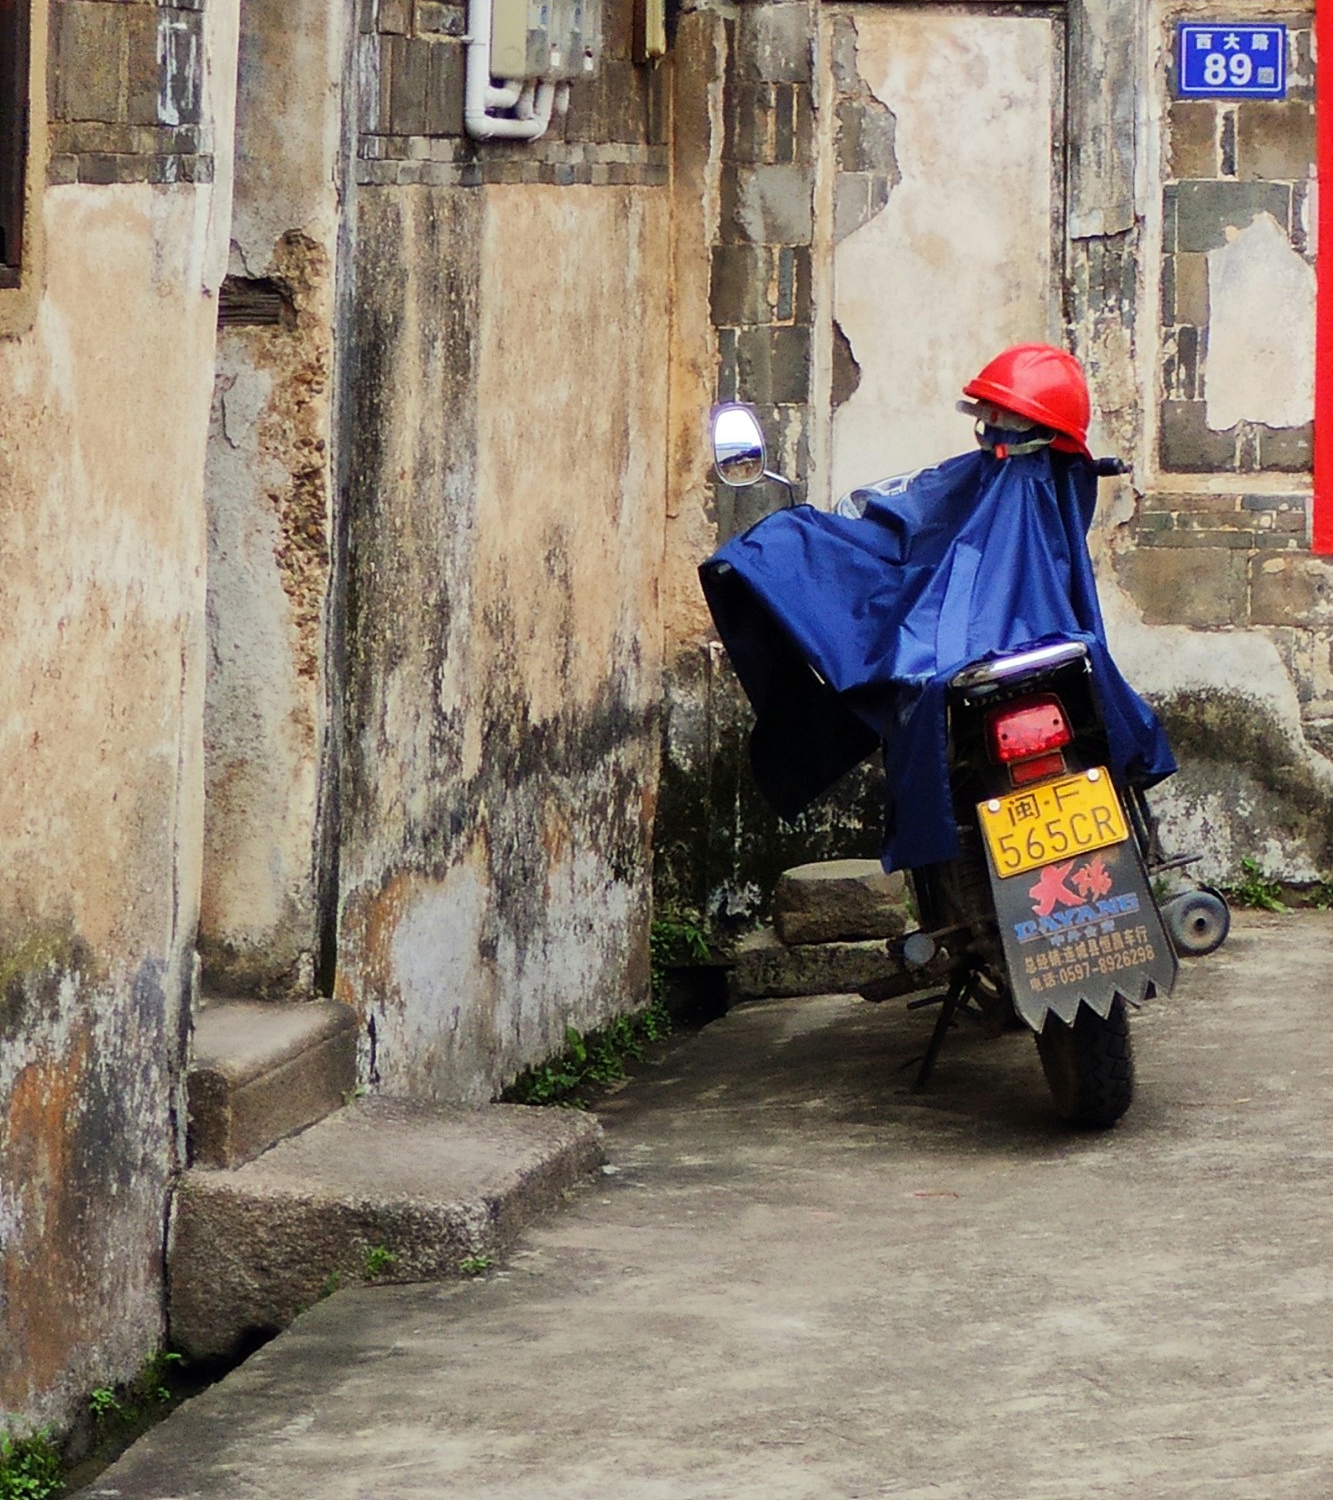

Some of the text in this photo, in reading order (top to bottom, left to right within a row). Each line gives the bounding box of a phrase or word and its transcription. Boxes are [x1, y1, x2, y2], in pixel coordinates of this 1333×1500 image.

[1203, 52, 1253, 86] 89
[998, 805, 1118, 868] 565CR
[1014, 892, 1140, 940] DAYANG
